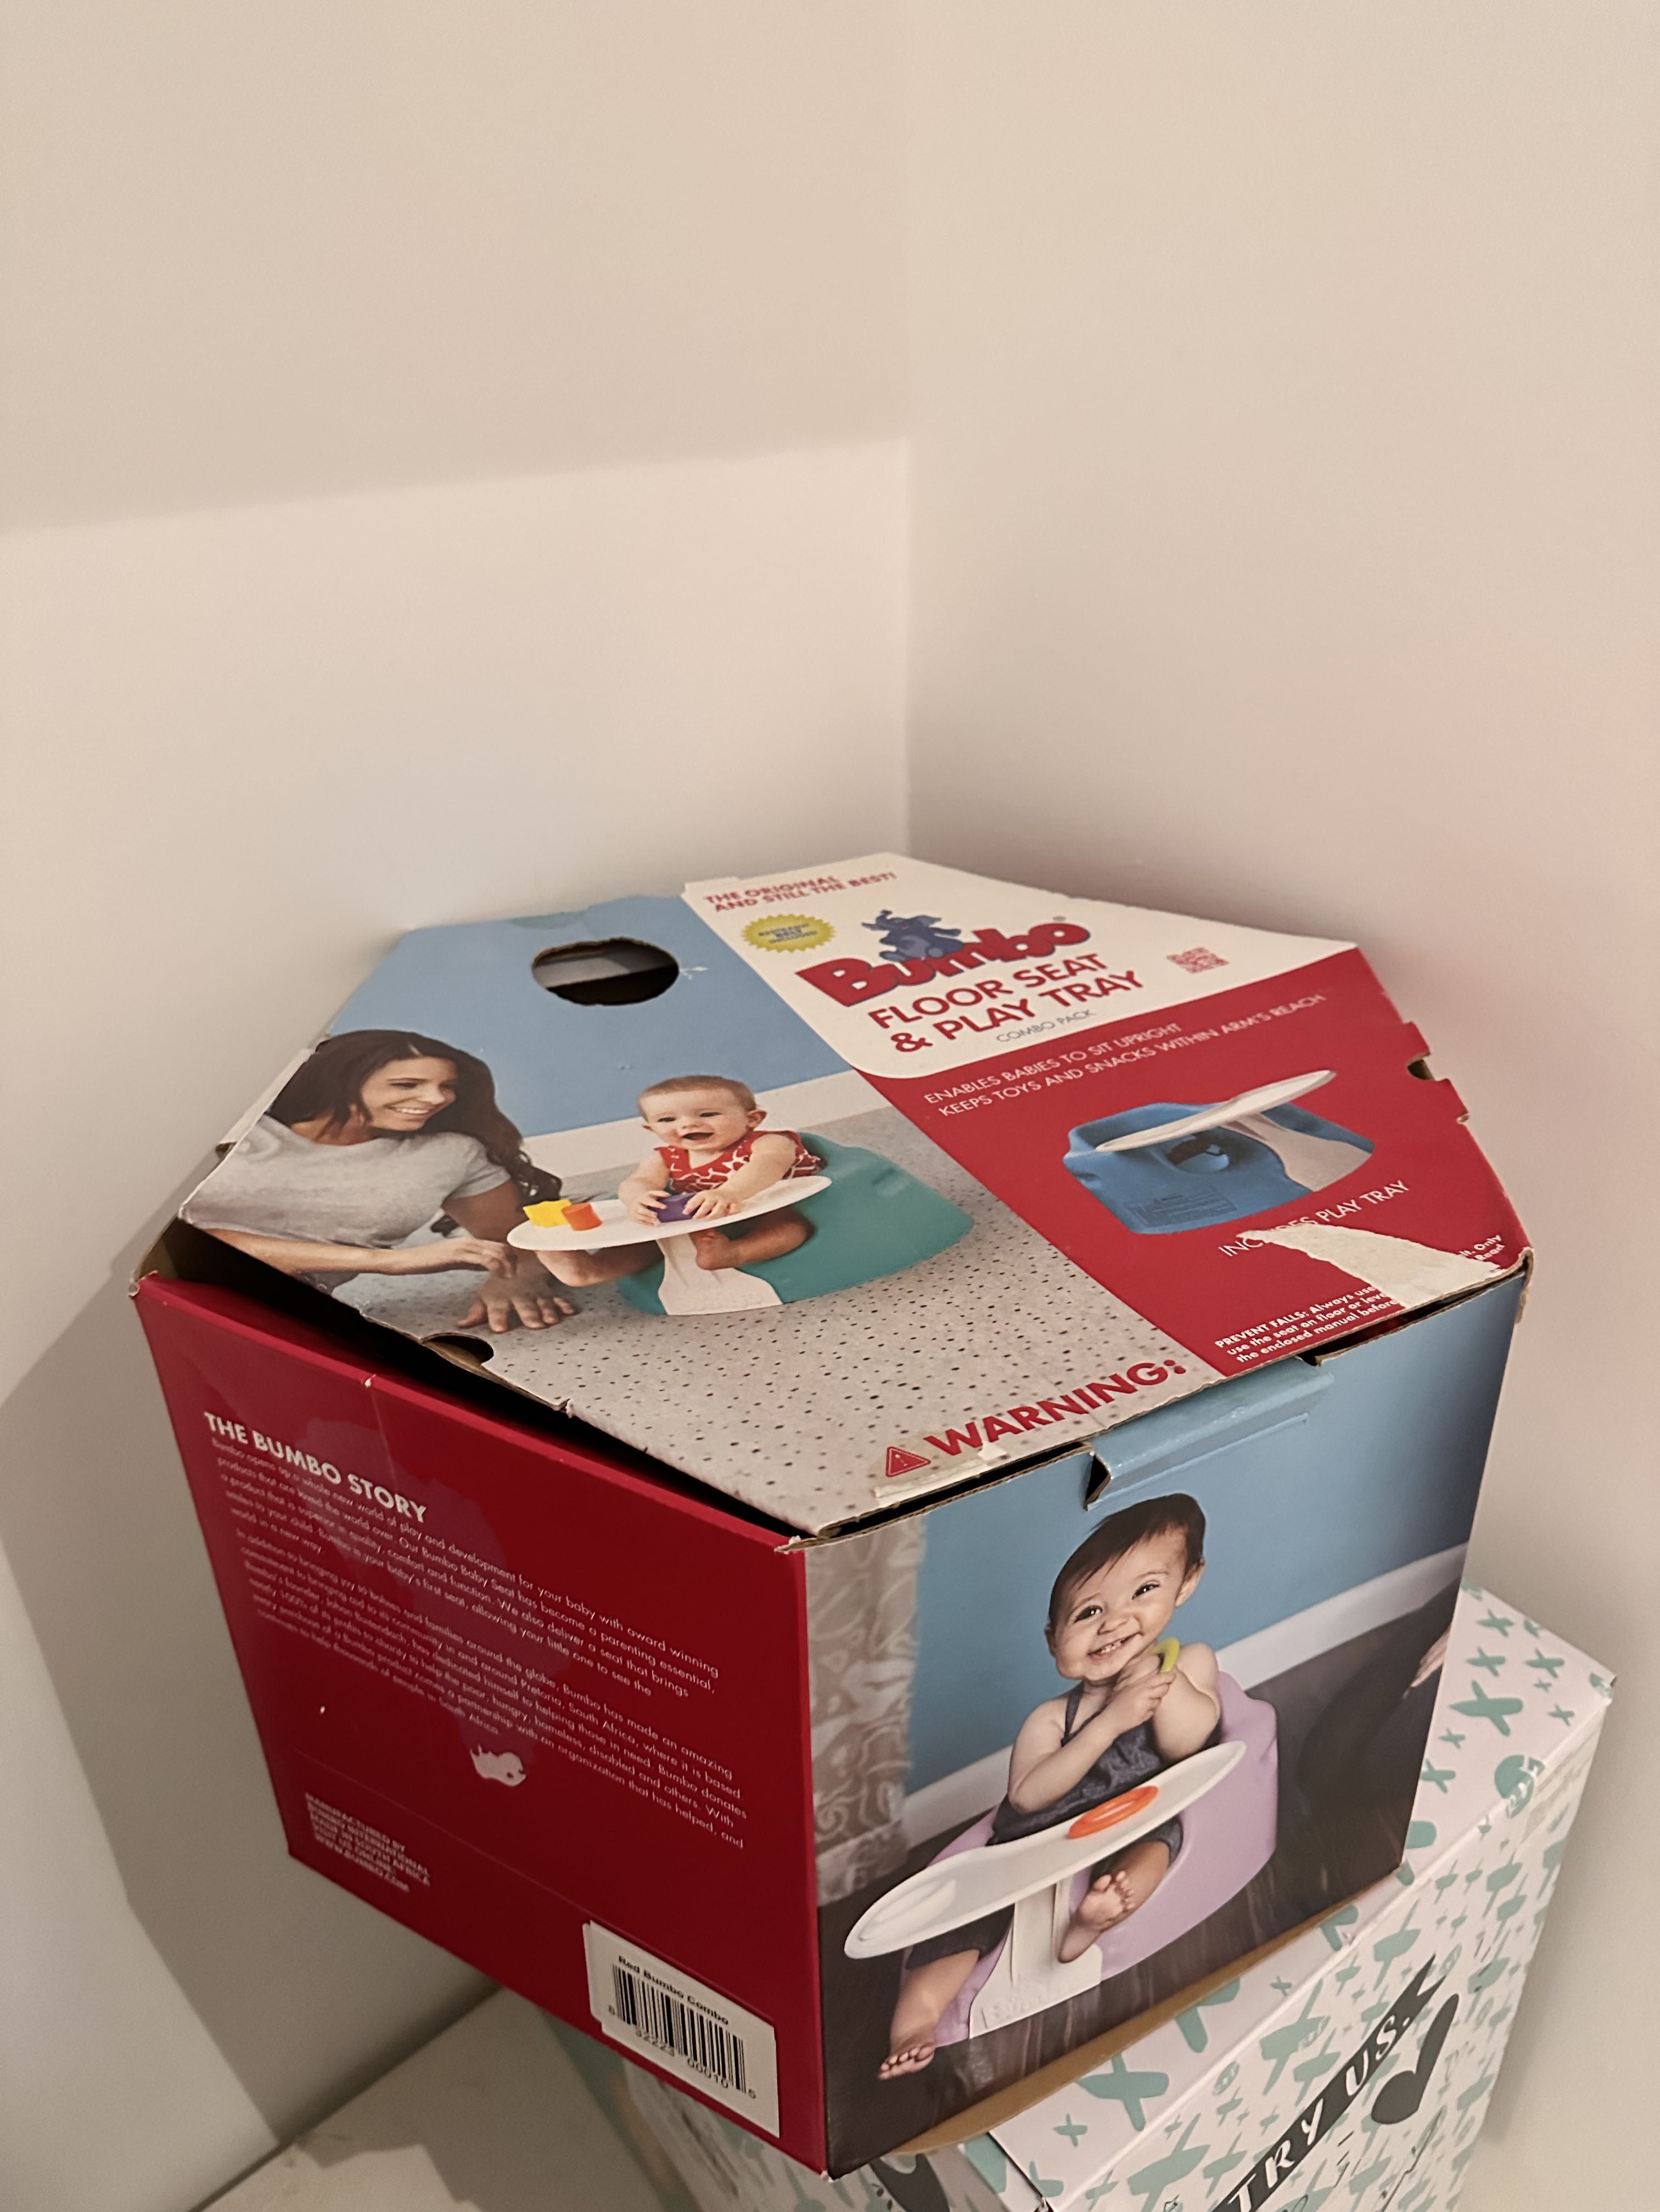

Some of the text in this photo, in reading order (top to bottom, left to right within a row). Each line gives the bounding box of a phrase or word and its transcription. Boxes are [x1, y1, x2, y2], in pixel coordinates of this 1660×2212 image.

[704, 876, 840, 903] THE ORIGINAL
[716, 872, 896, 912] AND STILL THE BEST!
[795, 923, 1090, 1007] Bumbo
[867, 953, 1108, 1029] FLOOR SEAT
[890, 970, 1144, 1053] & PLAY TRAY
[924, 1023, 1182, 1104] ENABLES BABIES TO SIT UPRIGHT
[938, 994, 1327, 1116] KEEPS TOYS AND SNACKS WITHIN ARM'S REACH
[996, 1009, 1093, 1043] COMBO PACK
[1315, 1199, 1362, 1222] PLAY
[1359, 1180, 1410, 1204] TRAY
[1214, 1234, 1502, 1348] PREVENT FALLS: Always use Only
[1227, 1343, 1250, 1355] use
[1250, 1334, 1272, 1346] the
[1272, 1326, 1298, 1338] seat
[1300, 1318, 1317, 1328] on
[1315, 1307, 1346, 1322] floor
[1348, 1301, 1362, 1310] or
[1360, 1292, 1388, 1304] leve
[1474, 1243, 1506, 1261] Read
[1236, 1298, 1399, 1363] the enclosed manual before
[924, 1359, 1186, 1456] WARNING:
[204, 1411, 249, 1444] THE
[253, 1429, 342, 1485] BUMBO
[348, 1473, 427, 1523] STORY
[471, 1604, 517, 1633] allowing
[519, 1627, 543, 1643] your
[547, 1636, 569, 1656] little
[572, 1652, 593, 1668] one
[596, 1661, 608, 1675] to
[611, 1670, 631, 1686] see
[633, 1680, 652, 1696] the
[491, 1578, 515, 1598] Seat
[517, 1590, 537, 1609] has
[540, 1601, 585, 1630] become
[588, 1626, 597, 1636] a
[600, 1632, 656, 1666] parenting
[659, 1660, 714, 1693] essential,
[497, 1598, 518, 1615] We
[521, 1611, 544, 1627] also
[547, 1622, 584, 1646] deliver
[587, 1643, 596, 1652] a
[599, 1648, 622, 1665] seat
[626, 1659, 648, 1677] that
[651, 1669, 688, 1697] brings
[518, 1574, 533, 1590] for
[537, 1586, 562, 1603] your
[565, 1596, 595, 1620] baby
[598, 1615, 623, 1631] with
[627, 1627, 666, 1652] award
[669, 1648, 719, 1678] winning
[480, 1661, 518, 1685] around
[520, 1678, 565, 1709] Pretoria,
[568, 1702, 598, 1725] South
[602, 1720, 638, 1748] Africa,
[642, 1743, 677, 1766] where
[681, 1760, 688, 1772] it
[692, 1767, 701, 1778] is
[483, 1675, 519, 1700] himself
[521, 1696, 532, 1708] to
[535, 1700, 575, 1731] helping
[577, 1723, 606, 1745] those
[609, 1741, 620, 1752] in
[658, 1764, 698, 1792] Bumbo
[700, 1788, 747, 1819] donates
[505, 1657, 522, 1672] the
[525, 1668, 559, 1691] globe,
[562, 1683, 601, 1710] Bumbo
[603, 1703, 624, 1722] has
[626, 1719, 658, 1740] made
[661, 1737, 677, 1750] an
[681, 1747, 732, 1781] amazing
[515, 1724, 538, 1739] with
[540, 1736, 554, 1749] an
[558, 1745, 625, 1784] organization
[628, 1779, 648, 1798] that
[652, 1790, 672, 1810] has
[675, 1803, 716, 1835] helped,
[720, 1831, 743, 1849] and
[534, 1715, 585, 1750] homeless,
[589, 1744, 635, 1775] disabled
[638, 1772, 660, 1789] and
[705, 1804, 733, 1827] With
[619, 1955, 729, 2025] Red Bumbo Combo
[687, 2058, 730, 2090] 00010
[748, 2089, 757, 2099] 5
[1227, 2015, 1410, 2212] TRY US.
